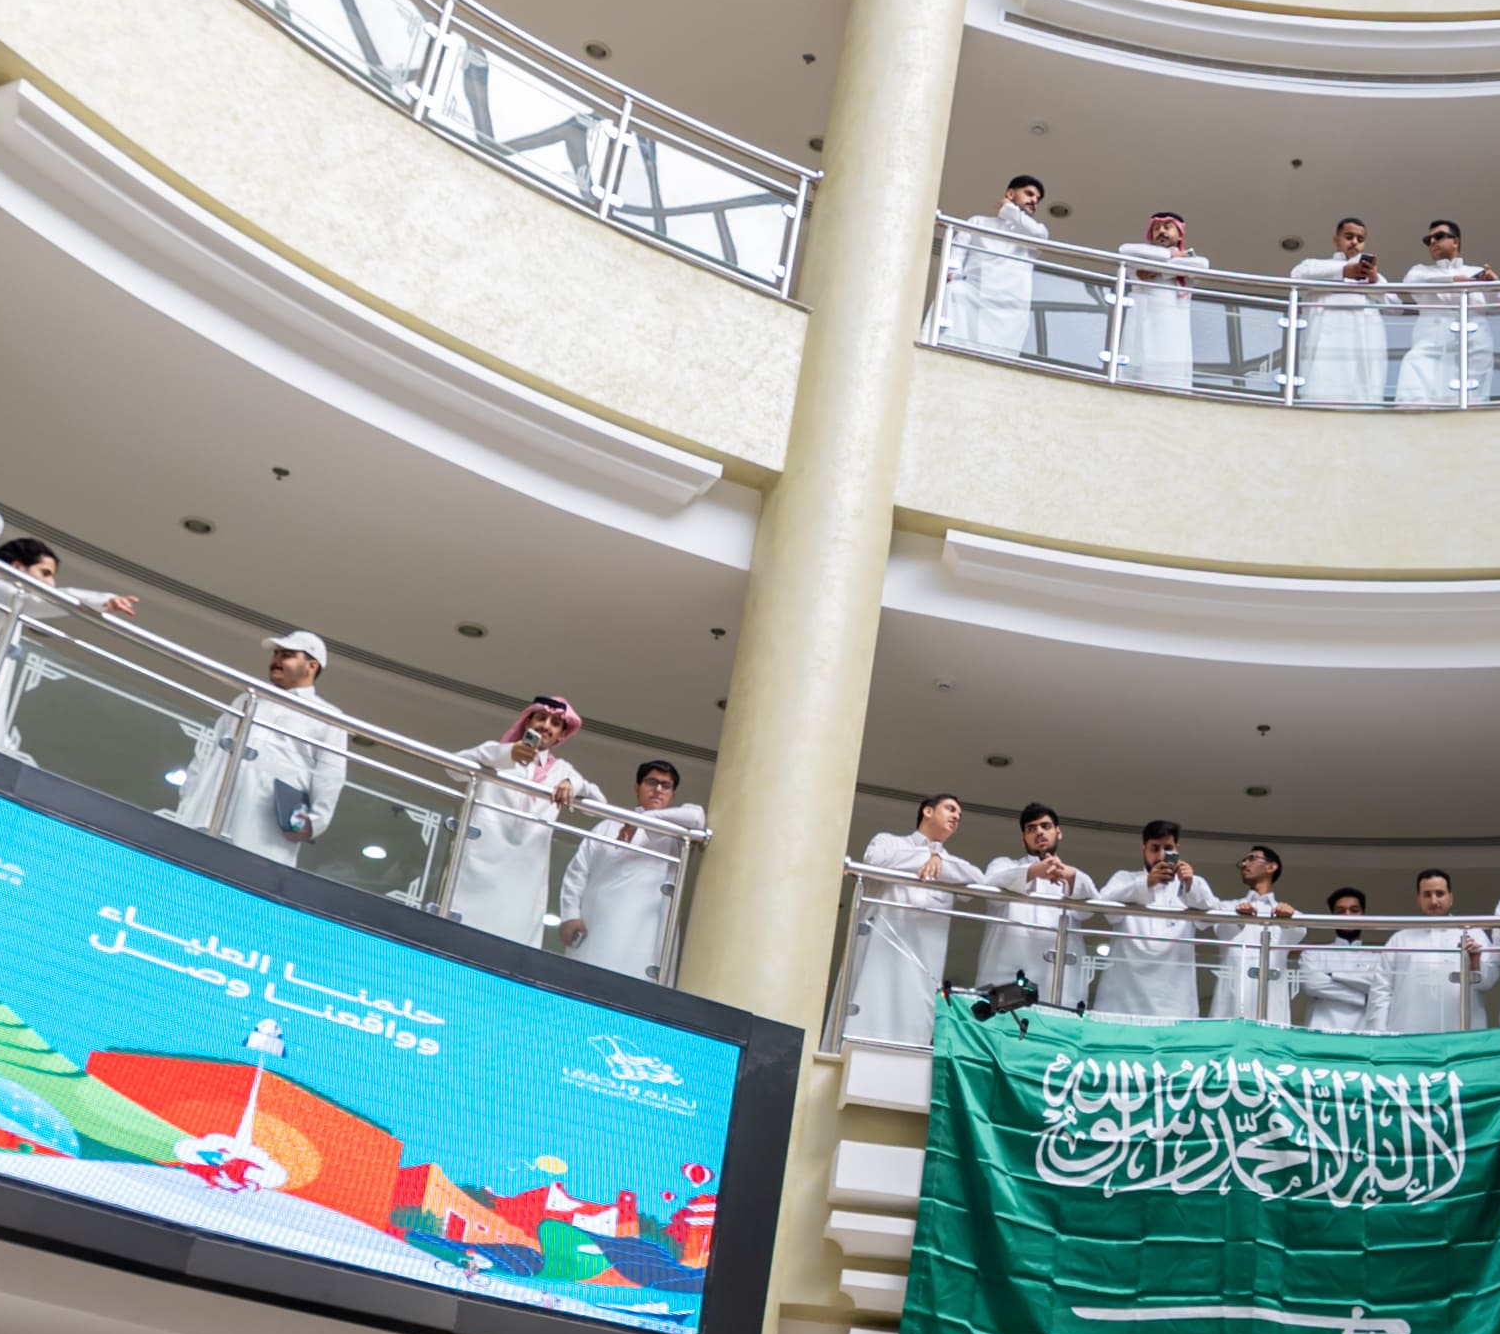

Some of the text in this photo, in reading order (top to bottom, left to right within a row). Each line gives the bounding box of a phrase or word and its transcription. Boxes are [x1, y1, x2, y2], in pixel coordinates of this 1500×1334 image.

[88, 930, 441, 1057] وواقعنا وصل
[97, 904, 446, 1026] حلمنا العلياء
